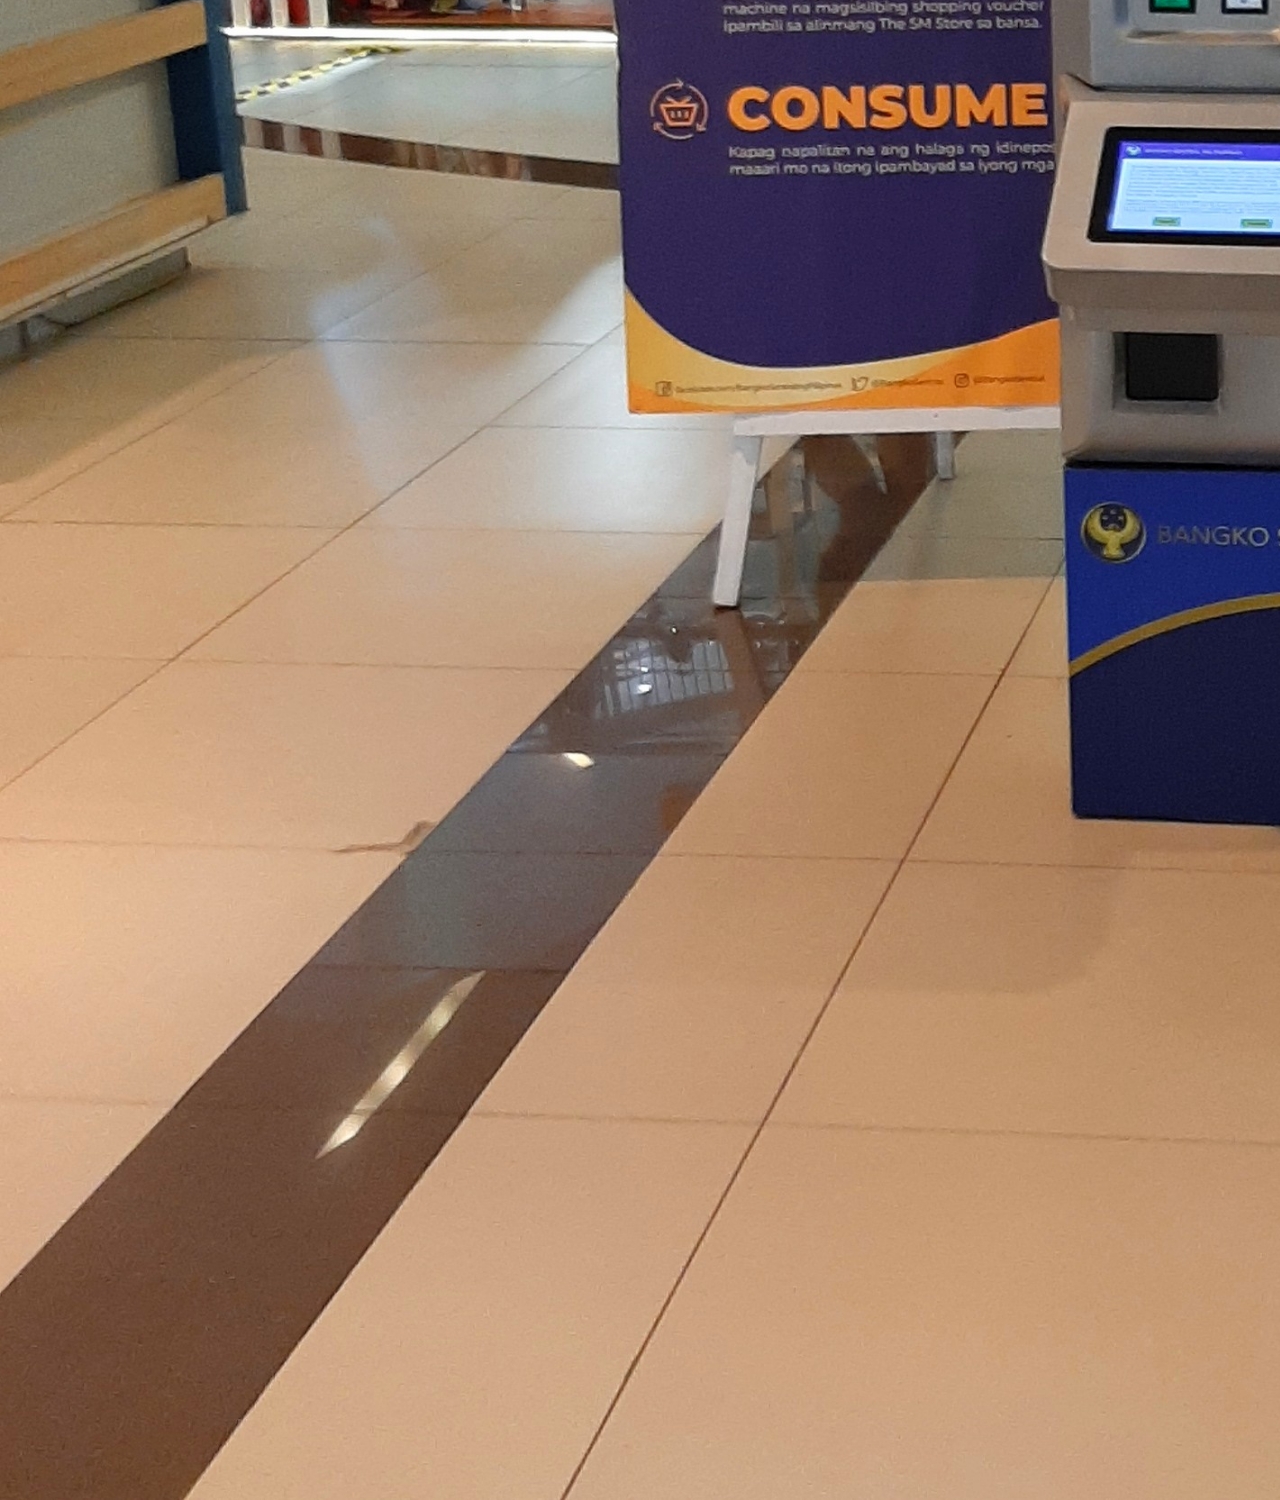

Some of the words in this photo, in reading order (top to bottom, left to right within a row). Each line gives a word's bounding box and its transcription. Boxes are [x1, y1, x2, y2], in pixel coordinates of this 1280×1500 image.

[723, 1, 788, 16] machine
[792, 3, 811, 15] na
[912, 0, 982, 16] shopping
[786, 19, 803, 32] sa
[878, 16, 907, 30] The
[908, 16, 933, 30] SM
[935, 16, 974, 30] Store
[976, 17, 993, 30] sa
[727, 82, 1049, 132] CONSUME
[856, 145, 876, 157] na
[880, 144, 910, 159] ang
[915, 142, 965, 158] halaga
[970, 143, 991, 158] ng
[783, 162, 809, 175] mo
[811, 162, 831, 175] na
[959, 160, 976, 173] sa
[1021, 159, 1055, 174] mga
[1156, 524, 1270, 548] BANGKO
